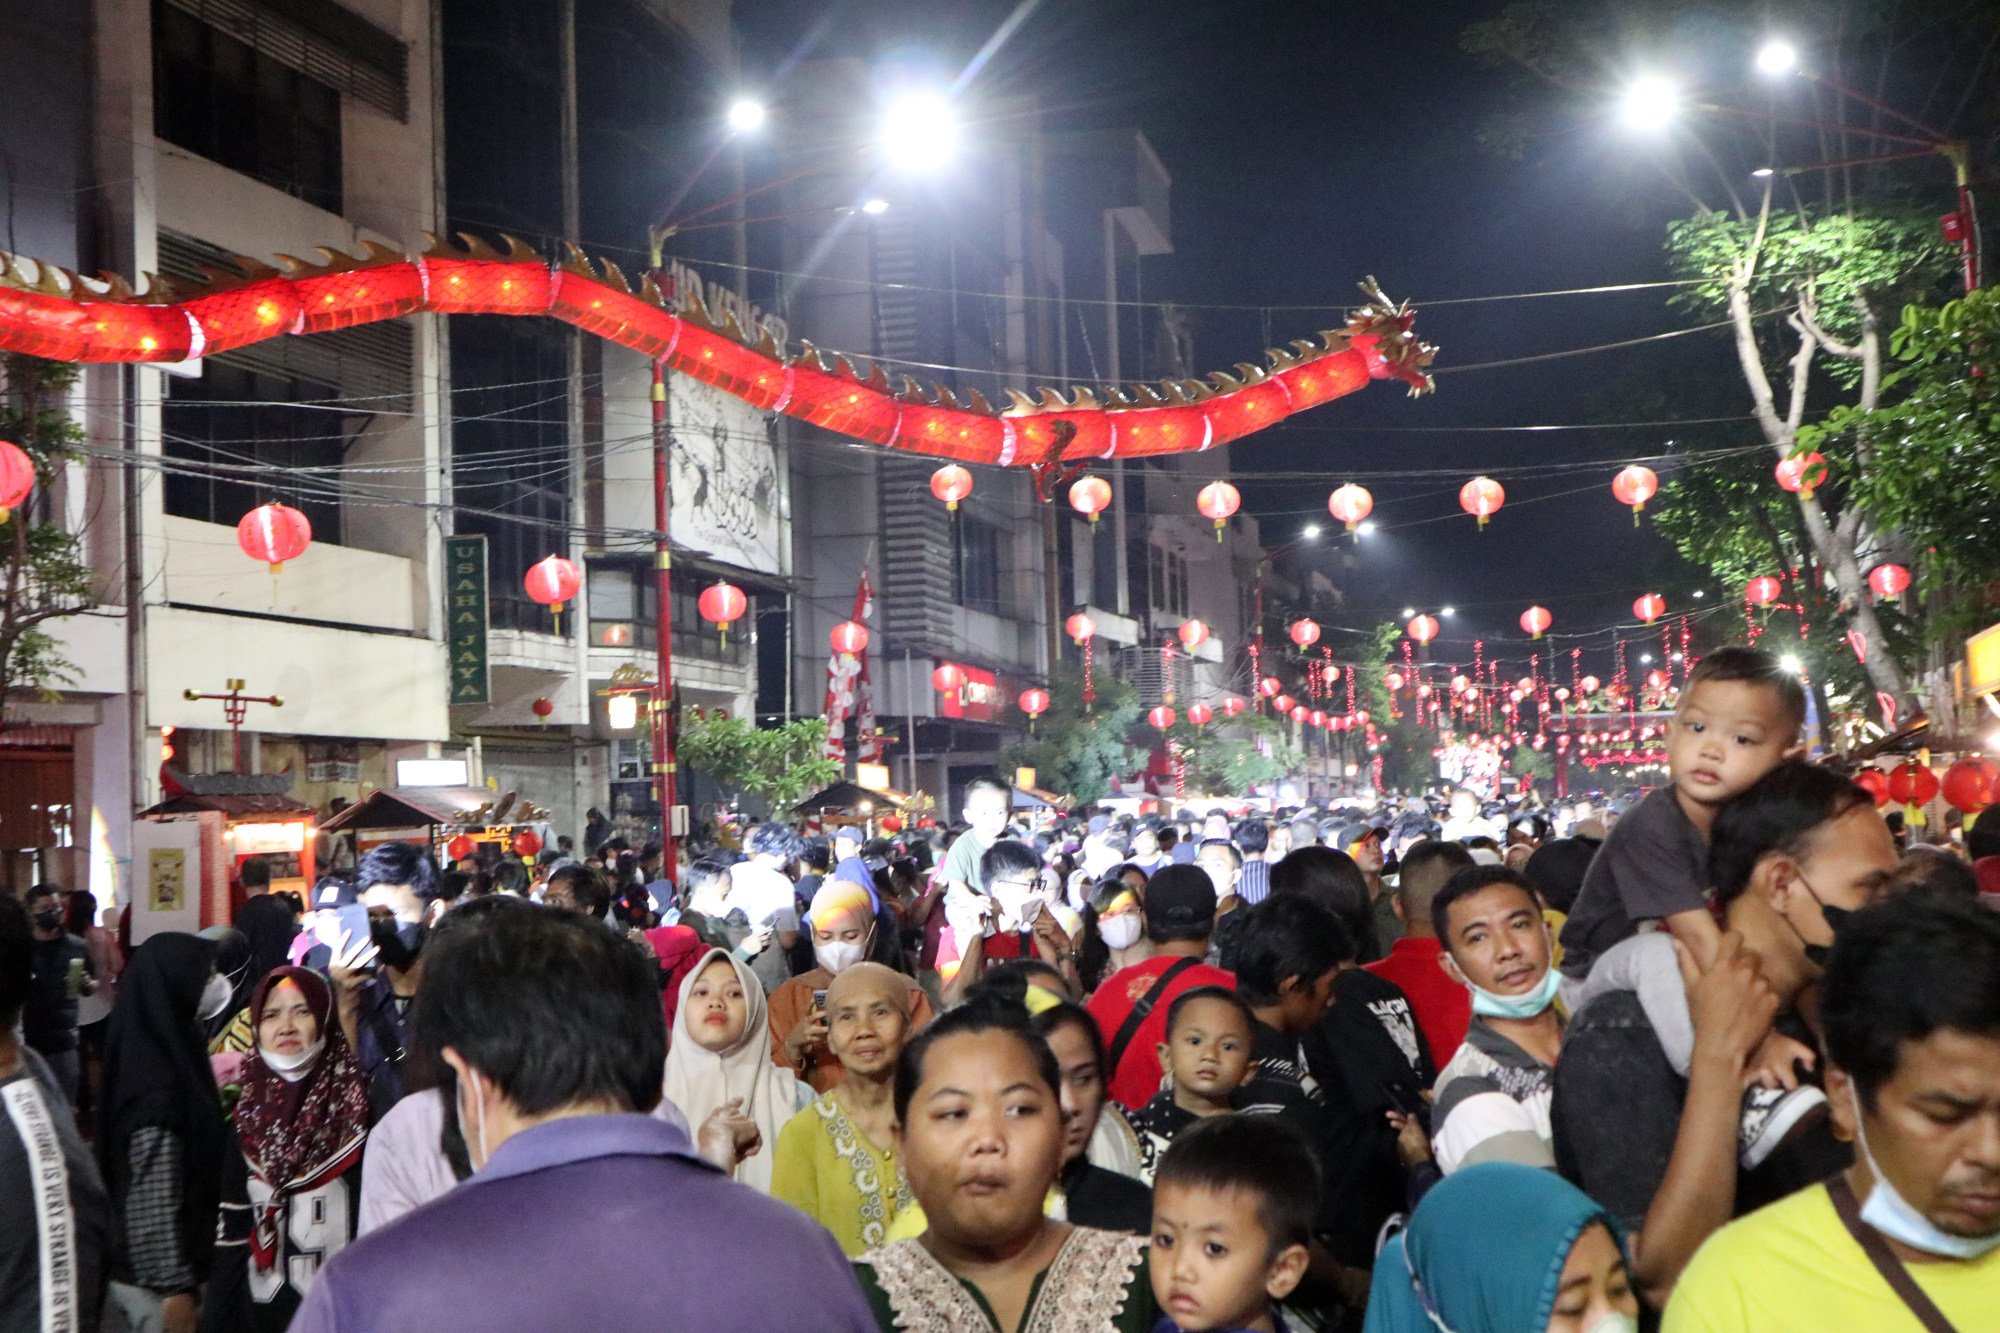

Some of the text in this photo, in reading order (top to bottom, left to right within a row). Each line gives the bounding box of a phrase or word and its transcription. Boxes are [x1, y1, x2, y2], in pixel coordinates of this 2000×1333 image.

[454, 546, 480, 697] USAHA JAYA
[45, 1182, 65, 1218] VERY
[48, 1221, 70, 1286] STRANGE
[52, 1290, 69, 1306] IS
